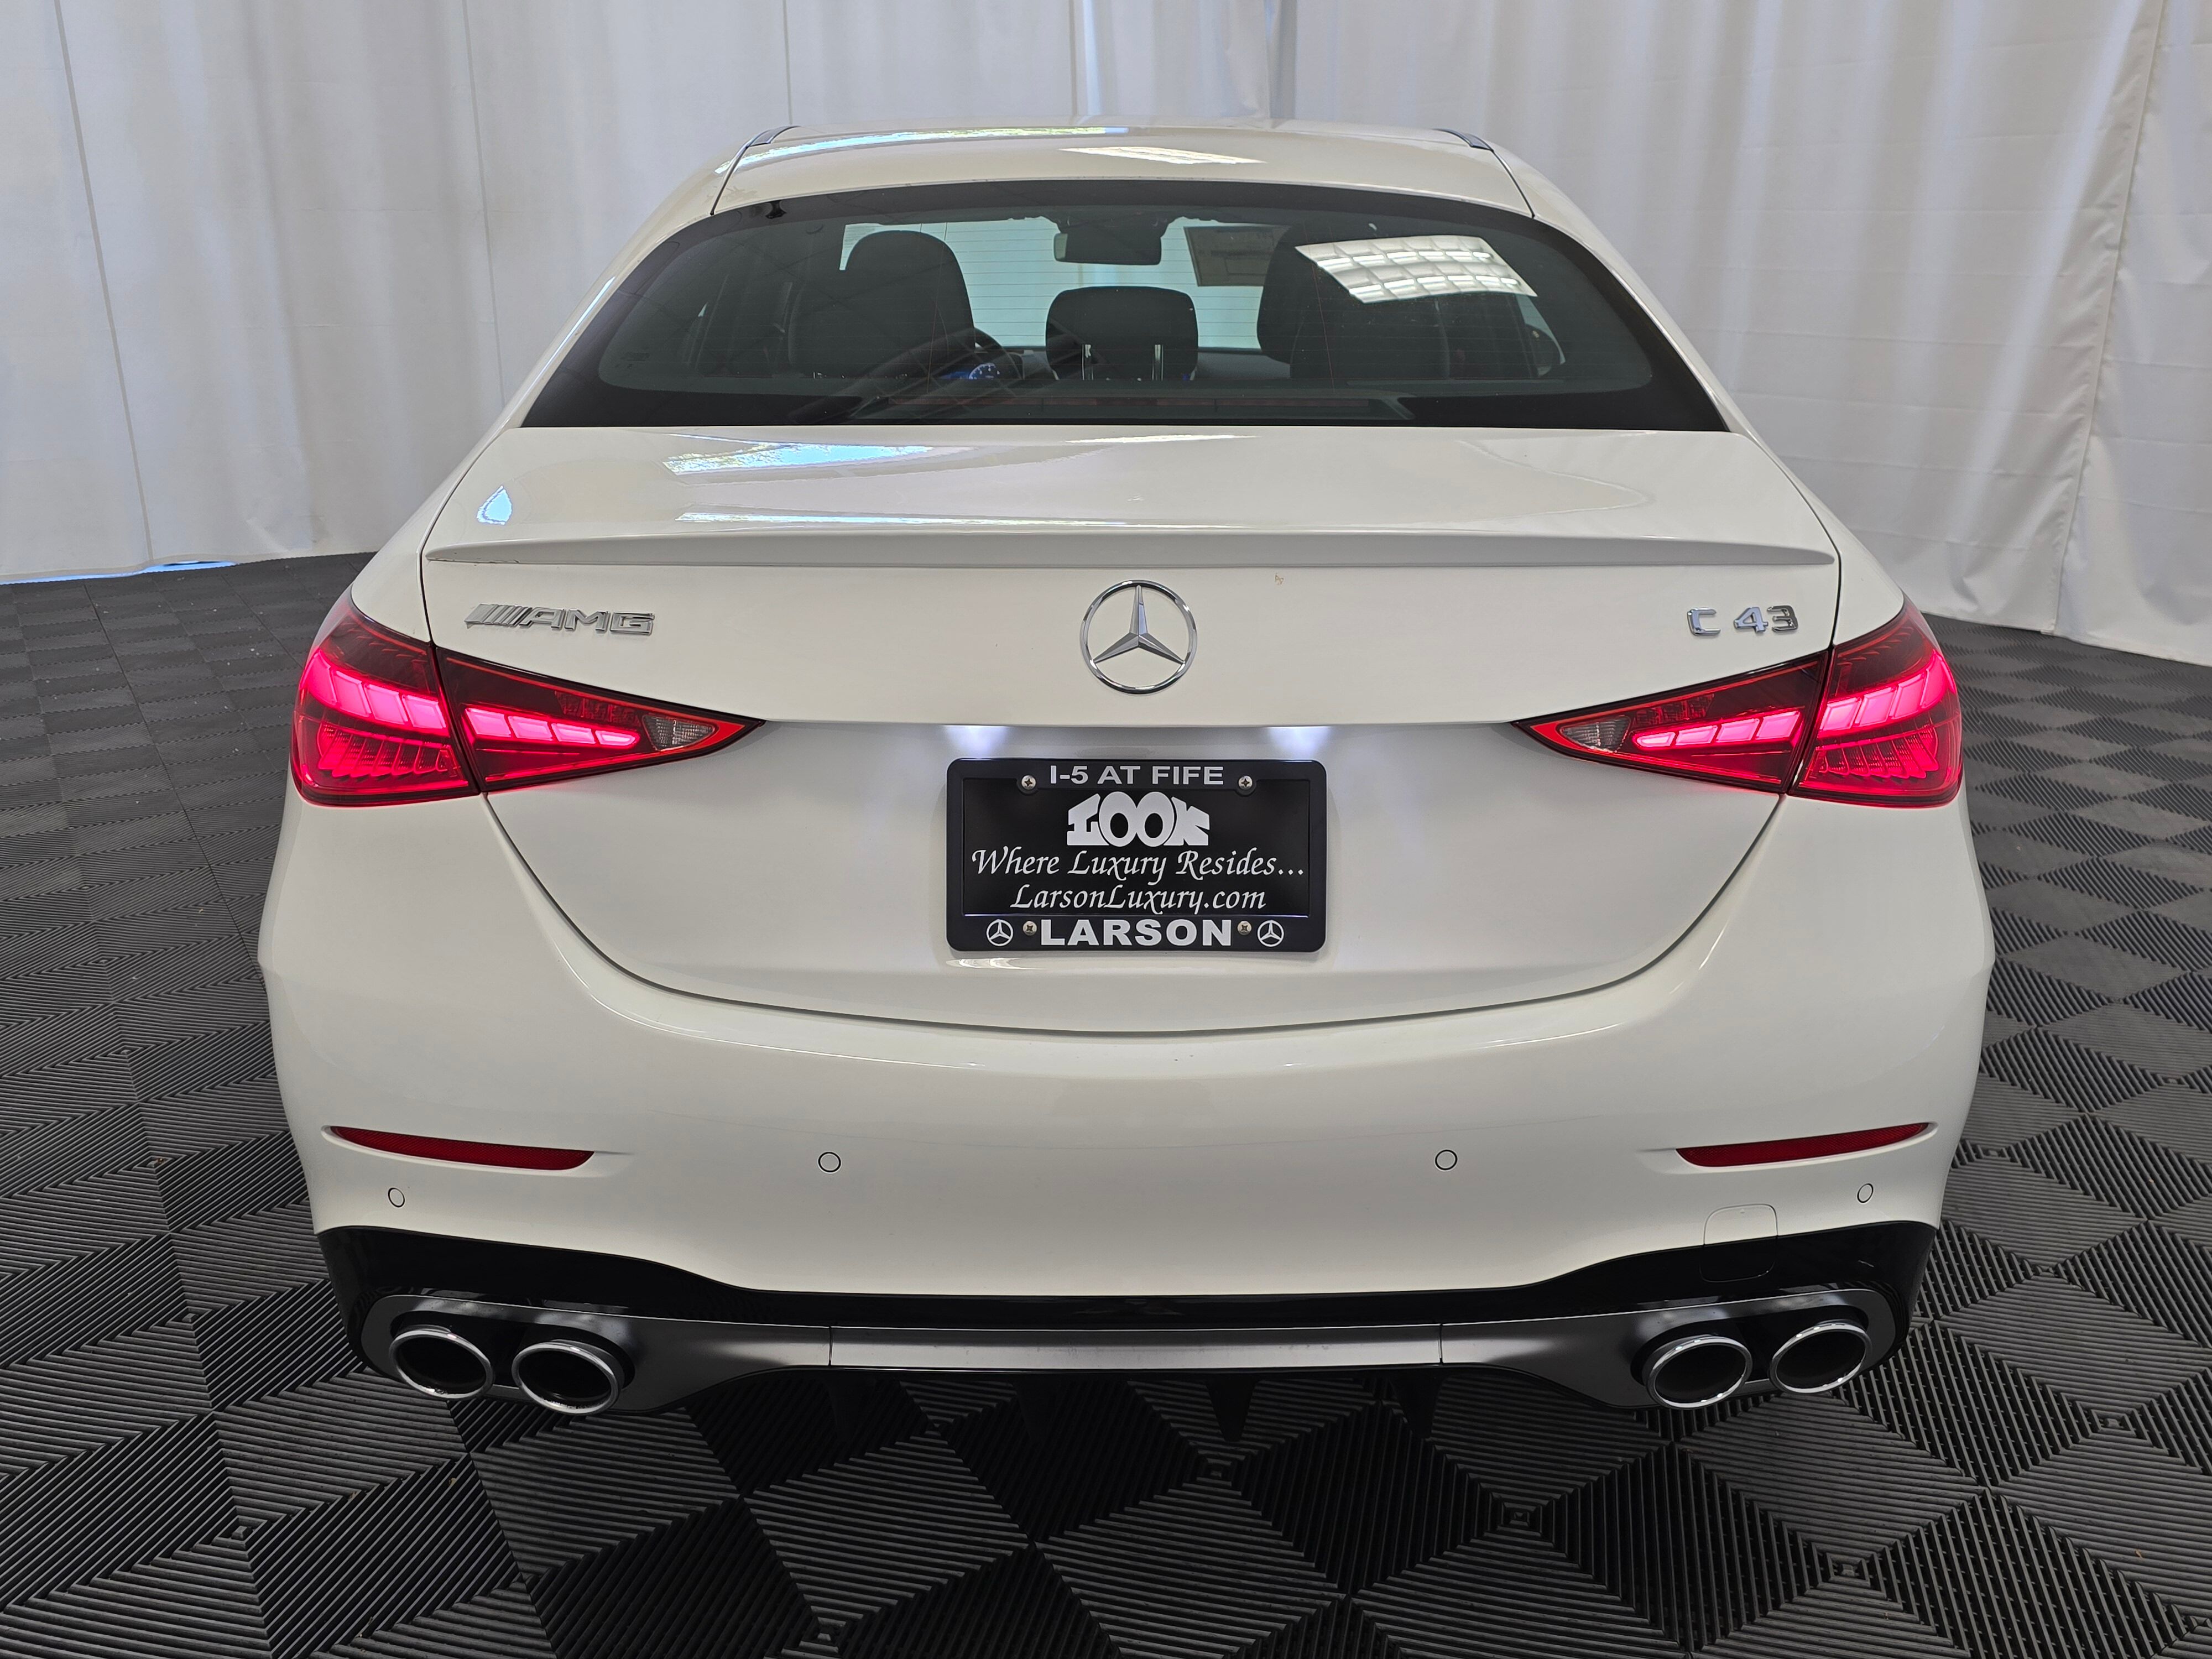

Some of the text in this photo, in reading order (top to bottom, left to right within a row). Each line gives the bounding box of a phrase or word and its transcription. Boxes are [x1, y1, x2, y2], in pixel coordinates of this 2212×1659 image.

[519, 607, 655, 635] AMG
[1687, 605, 1798, 636] C 43
[1050, 765, 1224, 785] I-5 AT FIFE
[1067, 791, 1210, 847] LOOK
[972, 846, 1304, 885] Where Luxury Resides...
[1010, 884, 1266, 916] LarsonLuxury.com
[1041, 919, 1232, 946] LARSON
